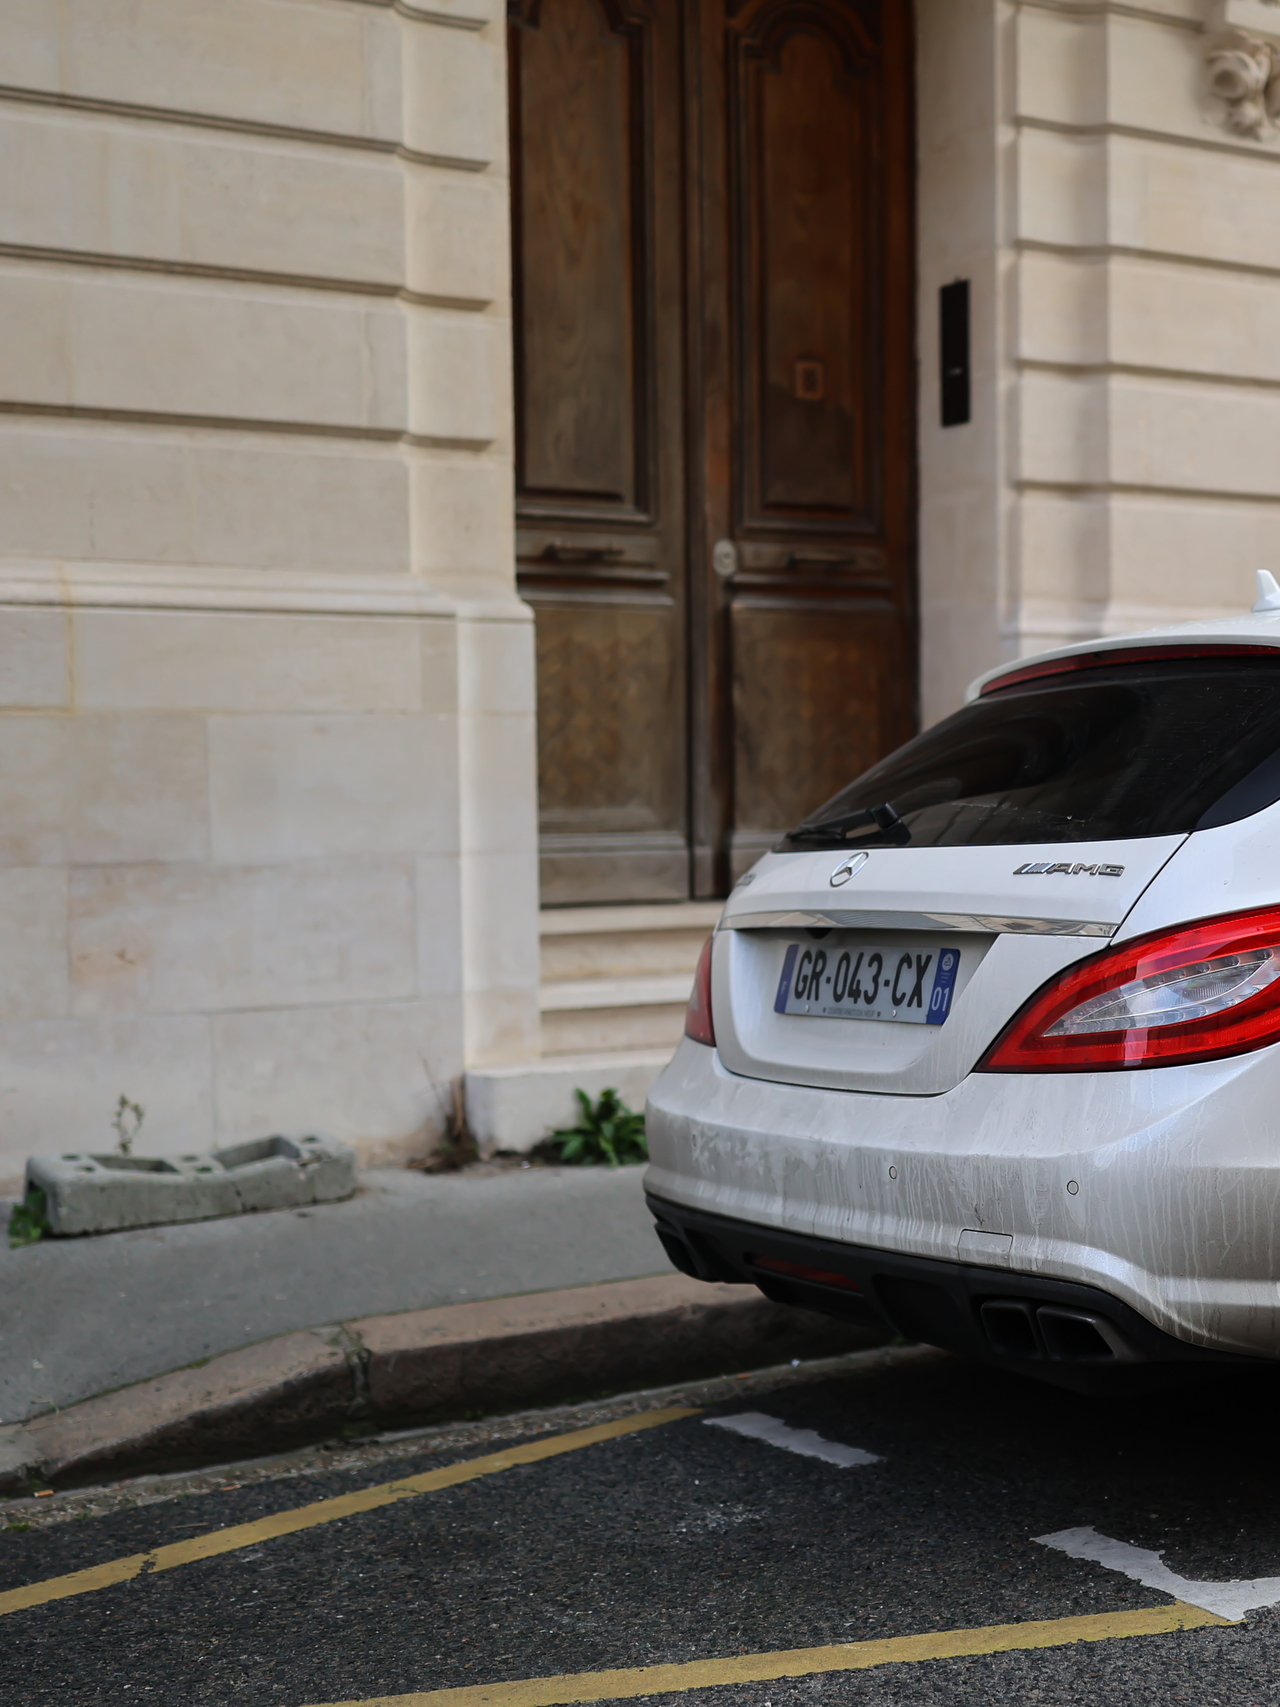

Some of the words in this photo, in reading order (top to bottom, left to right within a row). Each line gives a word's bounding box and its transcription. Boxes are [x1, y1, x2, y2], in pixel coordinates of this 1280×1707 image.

[1045, 863, 1126, 877] AMG
[794, 950, 932, 1009] GR-043-CX
[931, 986, 950, 1012] 01
